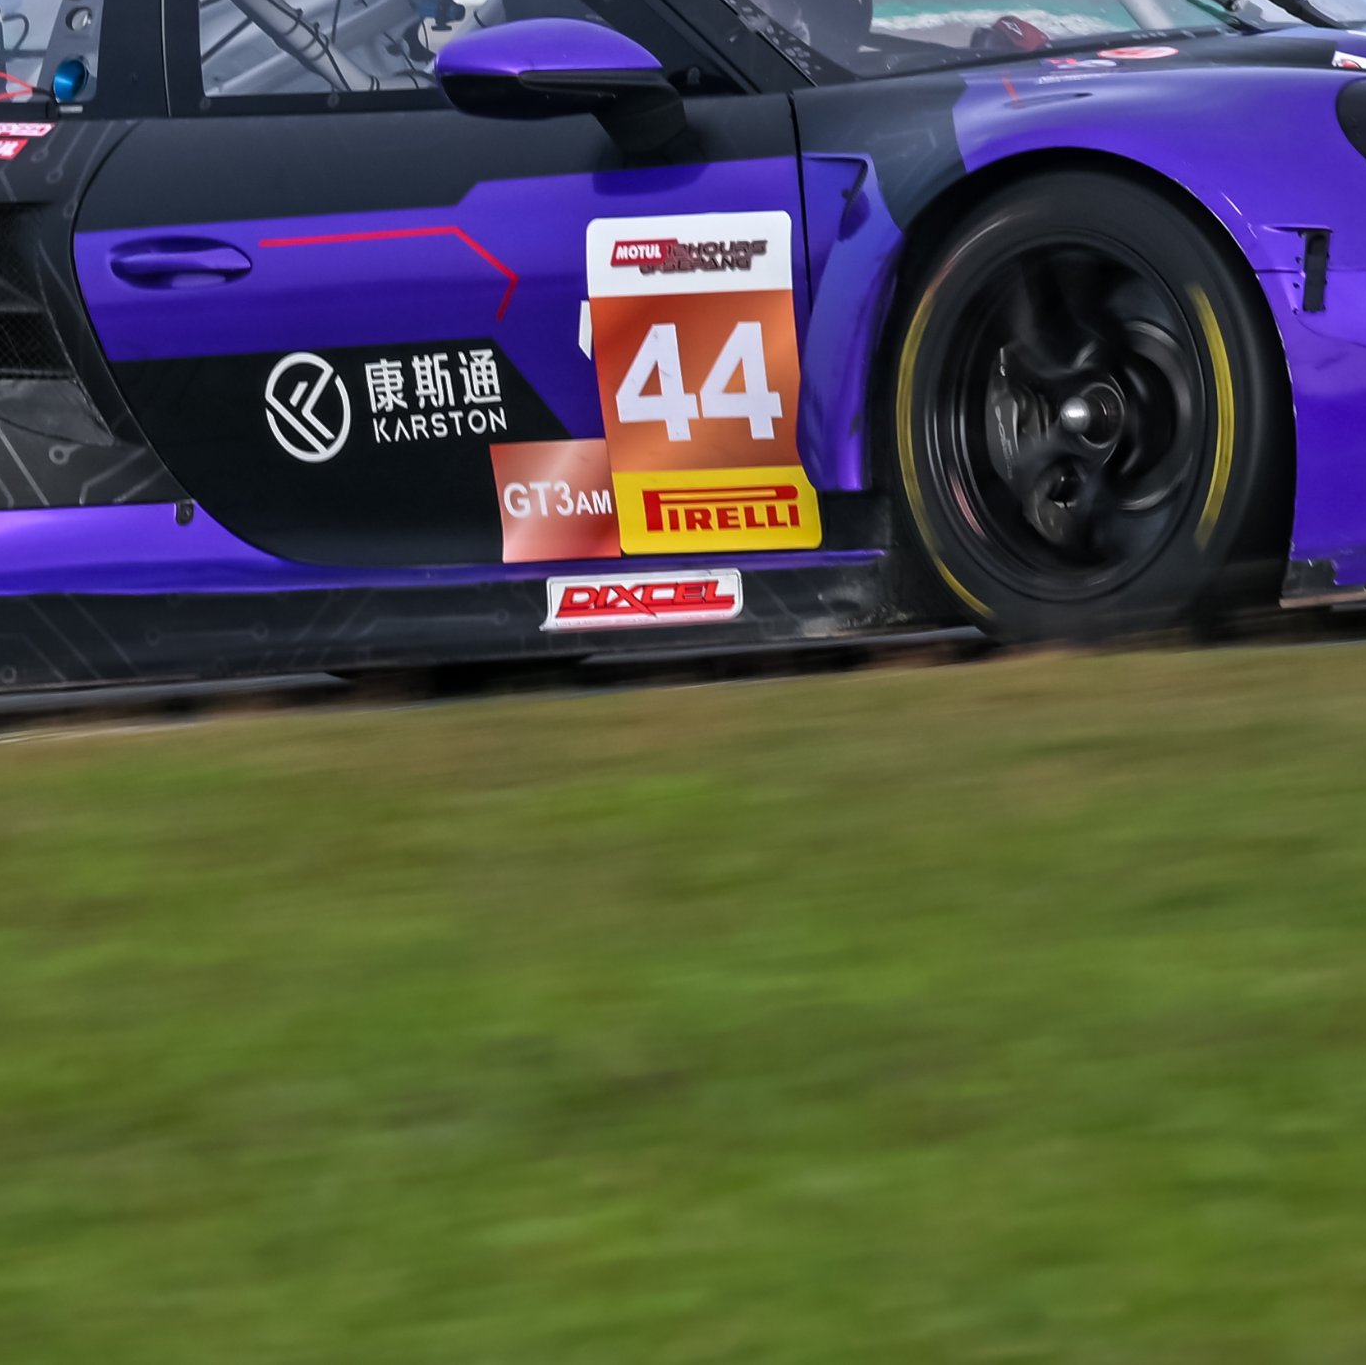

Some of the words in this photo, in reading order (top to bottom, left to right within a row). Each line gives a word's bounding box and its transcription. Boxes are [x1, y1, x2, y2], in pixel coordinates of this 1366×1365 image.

[615, 244, 662, 260] MOTUL
[364, 348, 503, 414] 康斯通
[615, 321, 783, 442] 44
[372, 406, 508, 443] KARSTON
[641, 484, 801, 532] PIRELLI
[556, 580, 736, 618] DIXCEL
